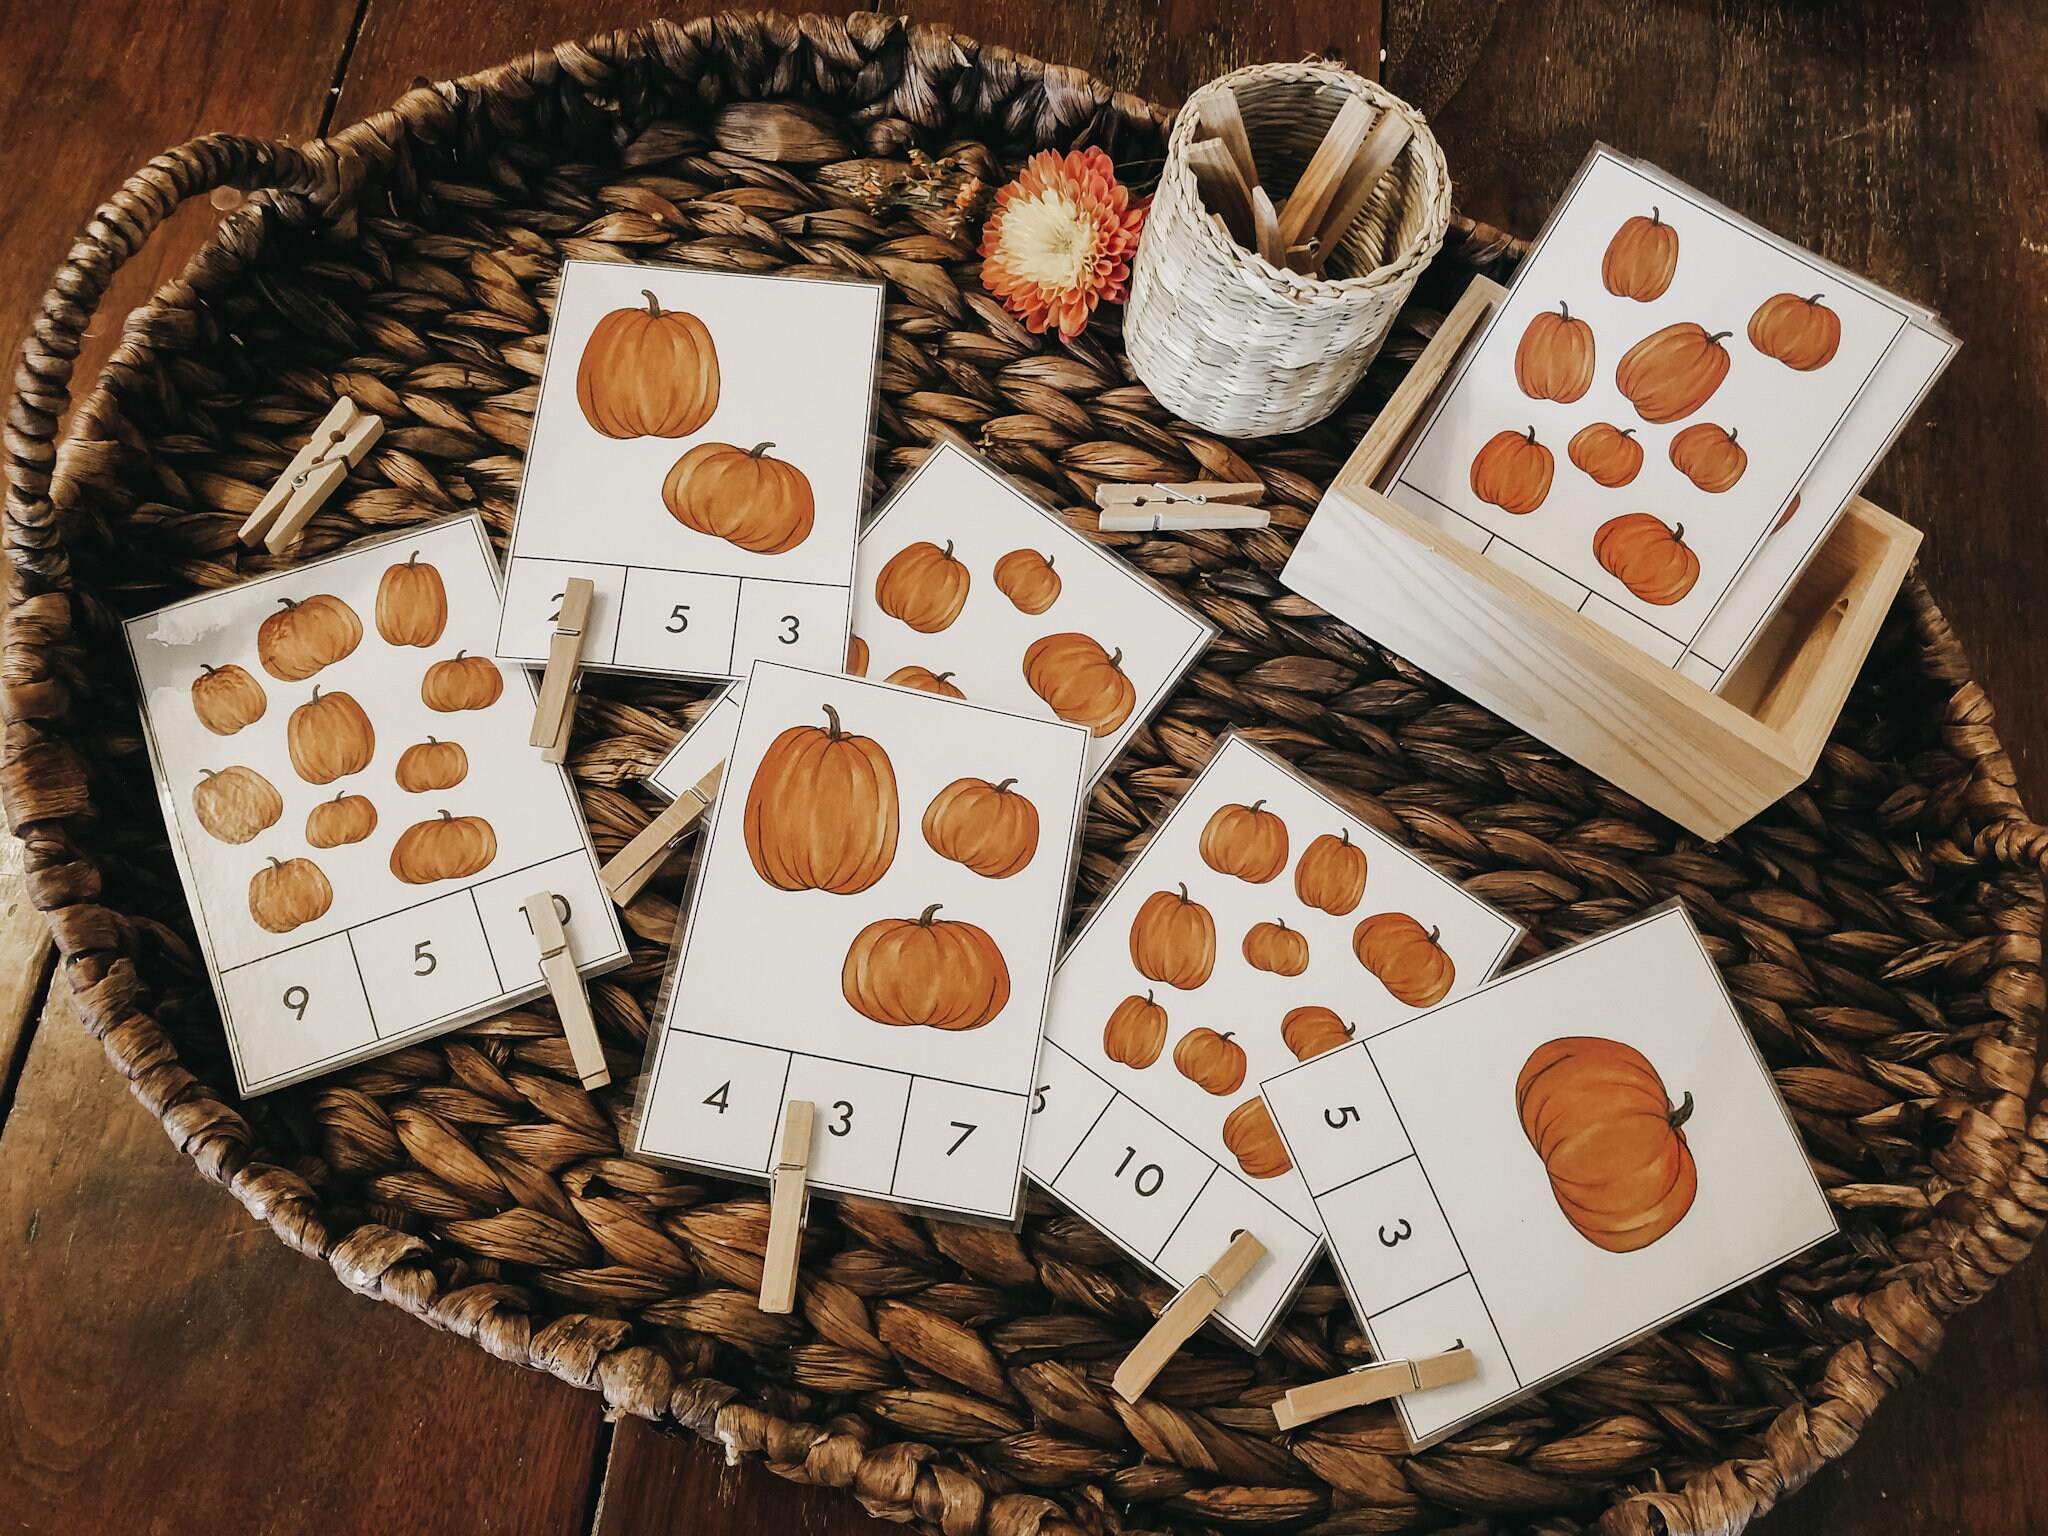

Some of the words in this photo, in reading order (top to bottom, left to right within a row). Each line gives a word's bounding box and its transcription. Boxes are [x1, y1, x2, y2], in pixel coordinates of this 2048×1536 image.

[665, 604, 690, 634] 5
[777, 615, 800, 645] 3
[282, 985, 310, 1021] 9
[413, 940, 437, 976] 5
[702, 1079, 731, 1114] 4
[828, 1100, 854, 1137] 3
[946, 1121, 978, 1156] 7
[1114, 1145, 1164, 1197] 10
[1324, 1106, 1361, 1129] 5
[1378, 1218, 1412, 1247] 3
